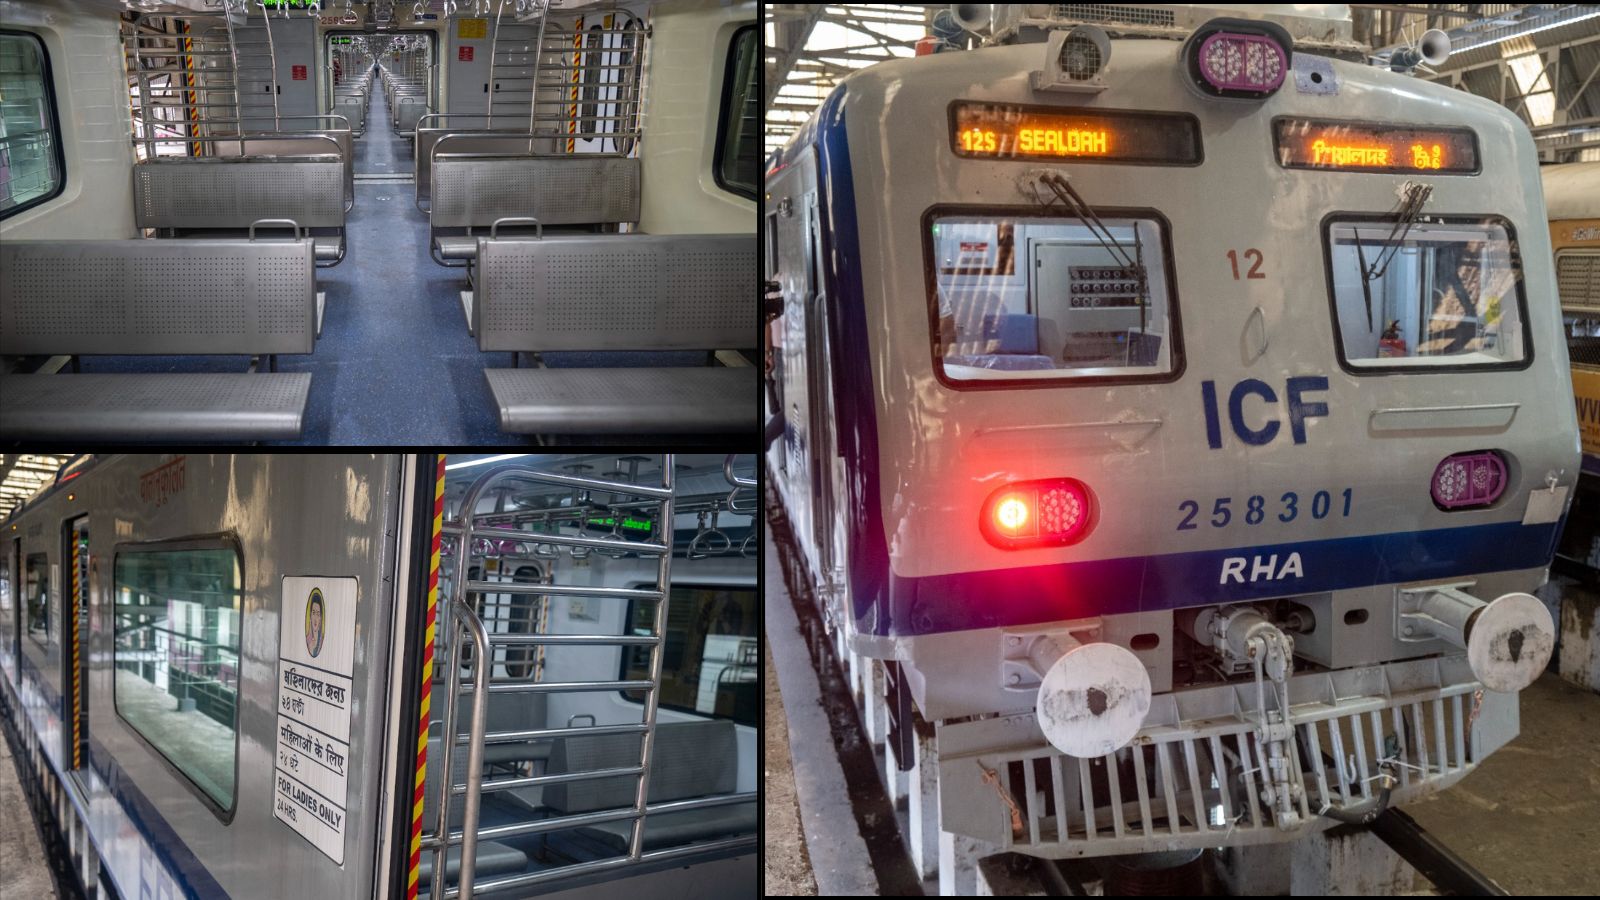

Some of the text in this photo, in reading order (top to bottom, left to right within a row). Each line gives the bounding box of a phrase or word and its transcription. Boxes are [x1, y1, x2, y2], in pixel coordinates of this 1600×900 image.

[1019, 129, 1106, 153] SEALDAH
[1226, 248, 1266, 280] 12
[1201, 376, 1329, 449] ICF
[1176, 488, 1353, 531] 258301
[1219, 552, 1304, 585] RHA
[314, 737, 324, 759] के
[325, 743, 345, 774] लिए
[277, 798, 298, 824] 24 HRS.
[278, 776, 342, 829] FOR LADIES ONLY
